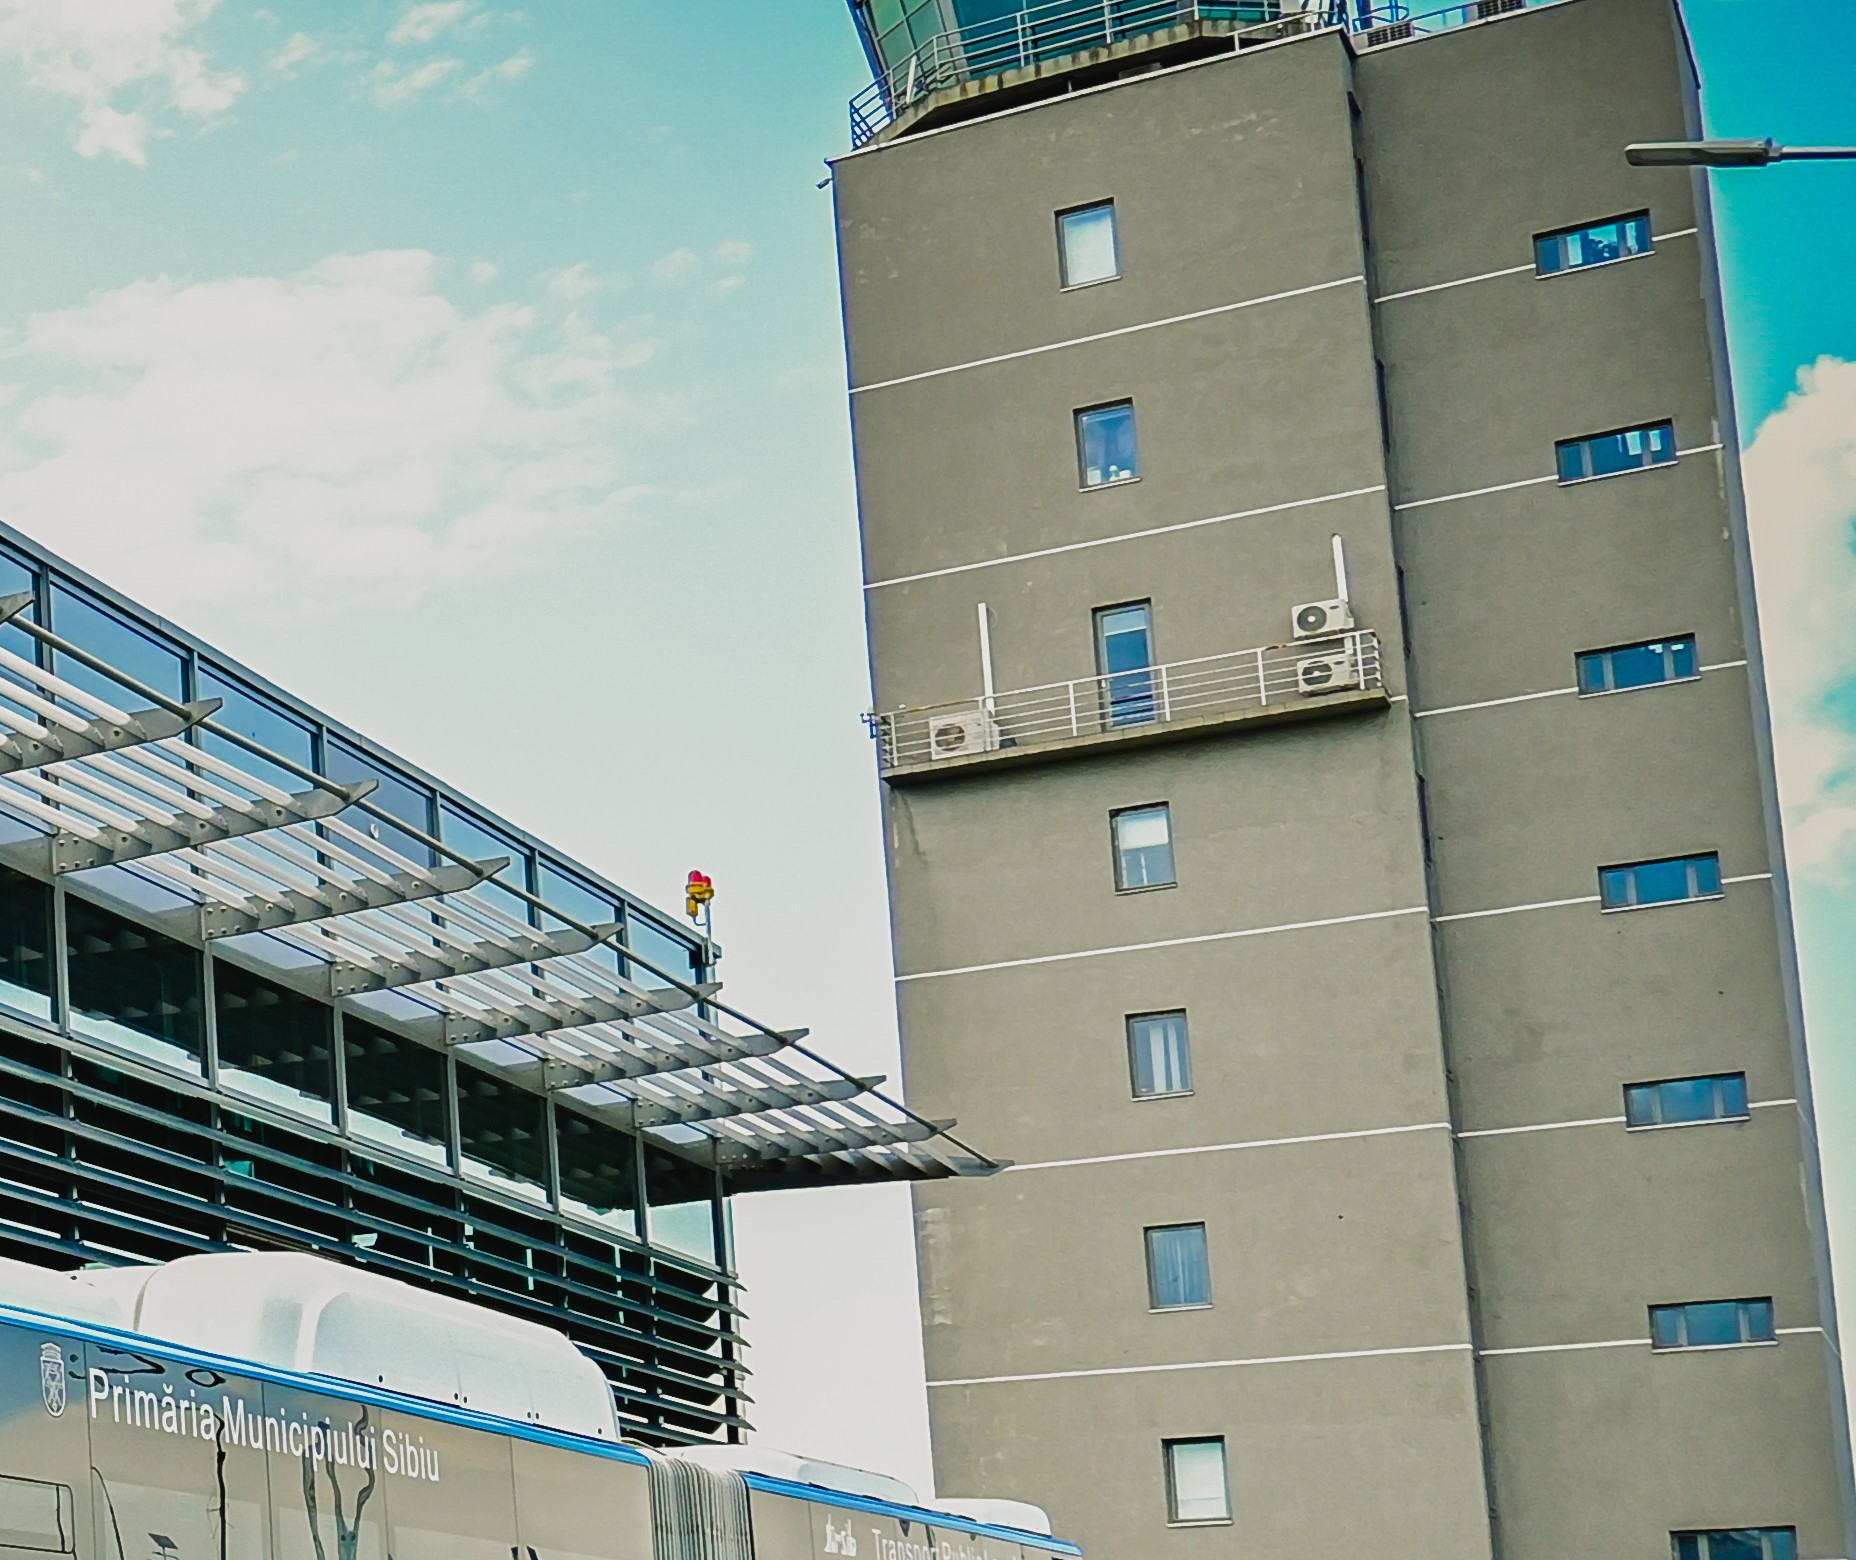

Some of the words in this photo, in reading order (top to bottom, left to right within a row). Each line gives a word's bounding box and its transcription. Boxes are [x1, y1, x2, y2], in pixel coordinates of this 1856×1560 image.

[88, 1367, 217, 1443] Primăria
[222, 1395, 378, 1472] Municipiului
[383, 1428, 440, 1482] Sibiu
